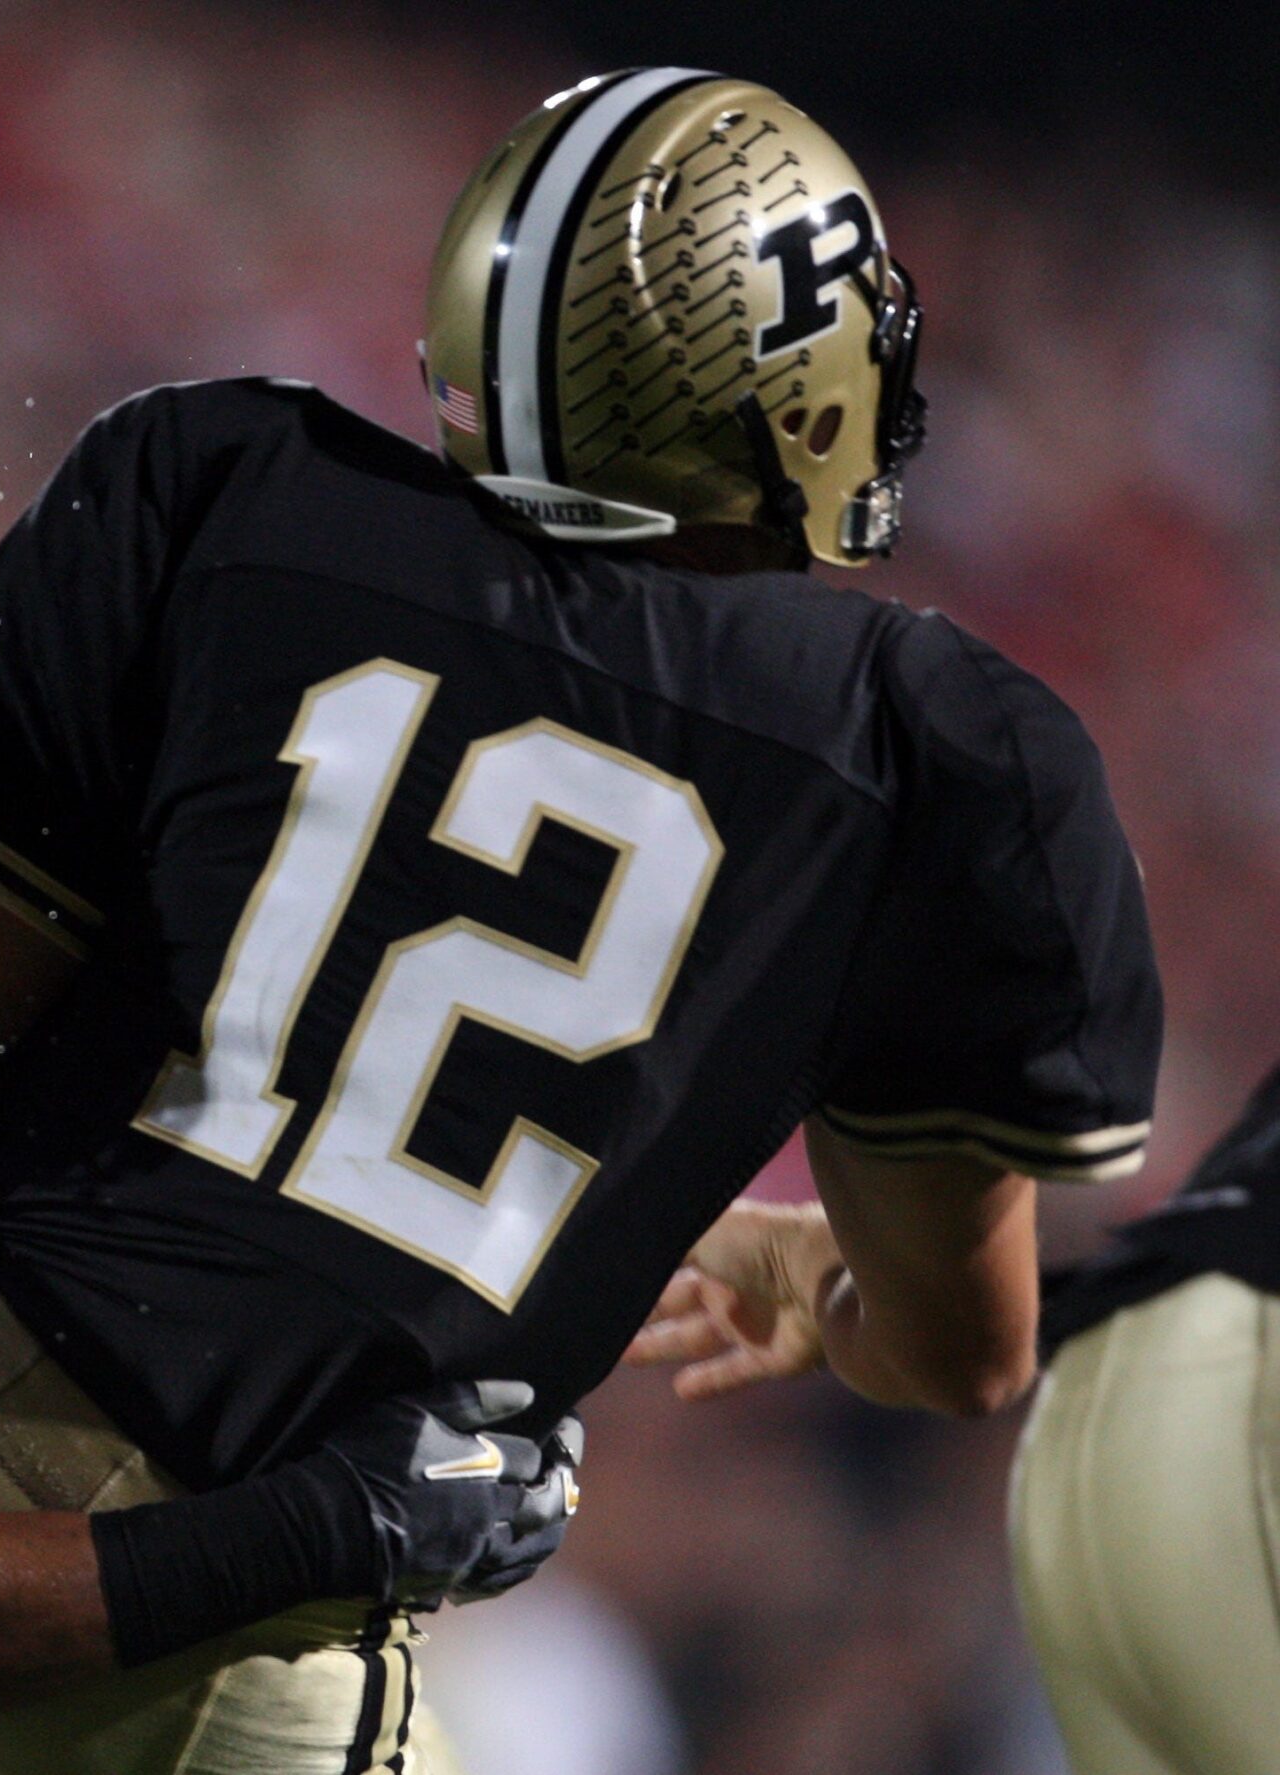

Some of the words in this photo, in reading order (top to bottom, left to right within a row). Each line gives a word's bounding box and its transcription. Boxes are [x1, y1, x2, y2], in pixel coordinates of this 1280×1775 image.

[753, 187, 876, 361] P
[503, 495, 605, 527] MAKERS
[130, 656, 725, 1315] 12
